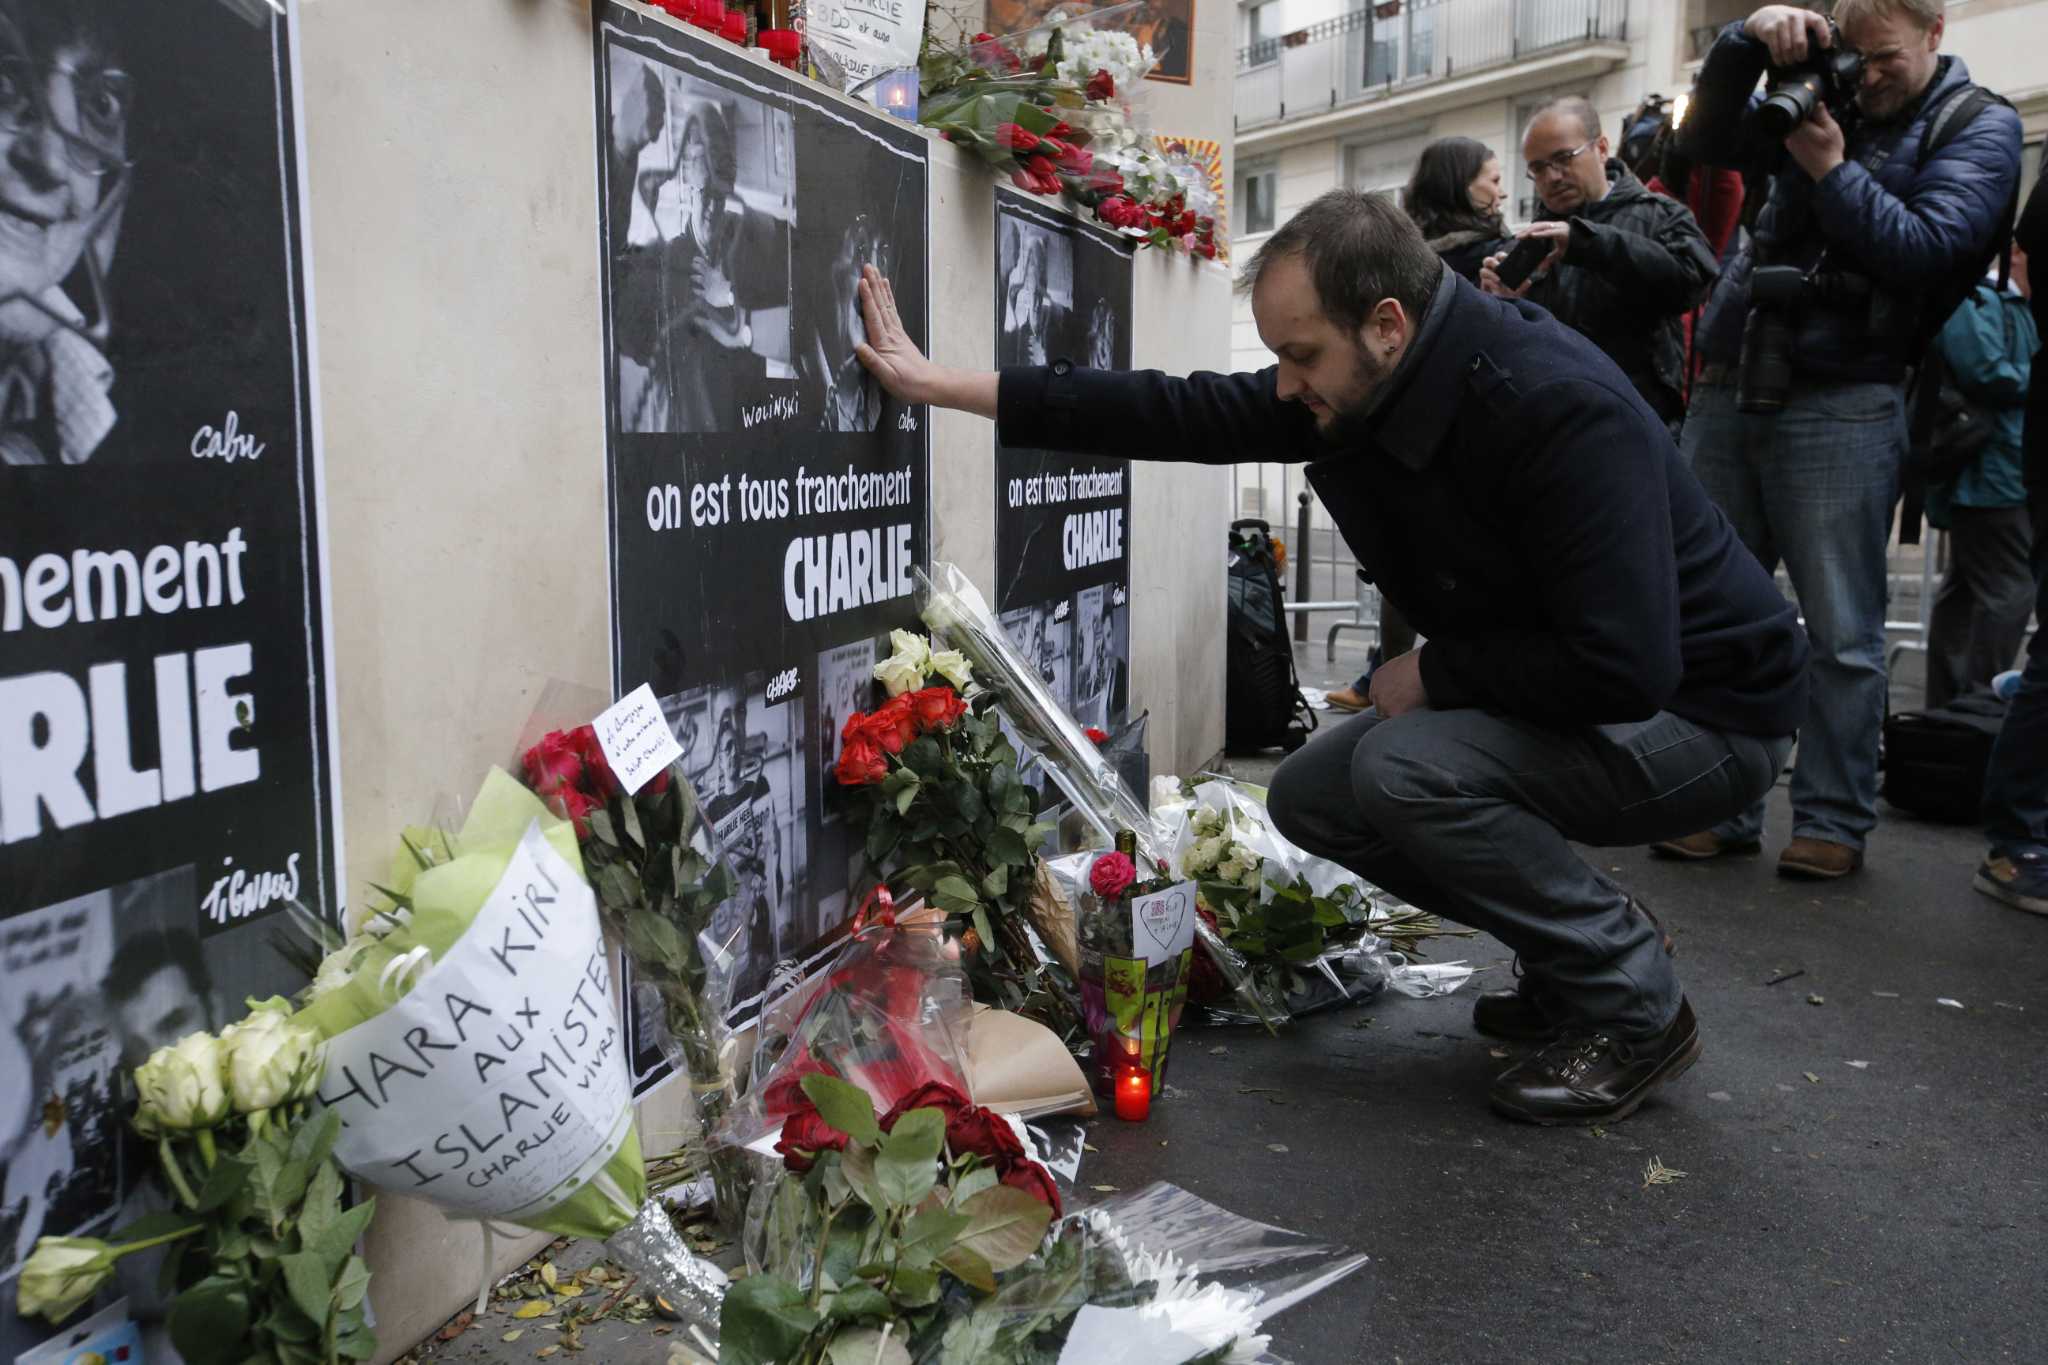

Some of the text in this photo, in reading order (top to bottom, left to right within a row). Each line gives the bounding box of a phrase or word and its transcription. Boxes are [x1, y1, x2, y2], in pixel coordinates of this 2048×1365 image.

[190, 410, 266, 463] cabu
[646, 464, 912, 532] on est tous franchement
[1008, 466, 1124, 508] on est tous franchement
[784, 523, 913, 622] CHARLIE
[1063, 507, 1123, 571] CHARLIE
[316, 993, 491, 1128] HARA
[474, 997, 540, 1083] AUX
[466, 1102, 570, 1188] CHARLIE
